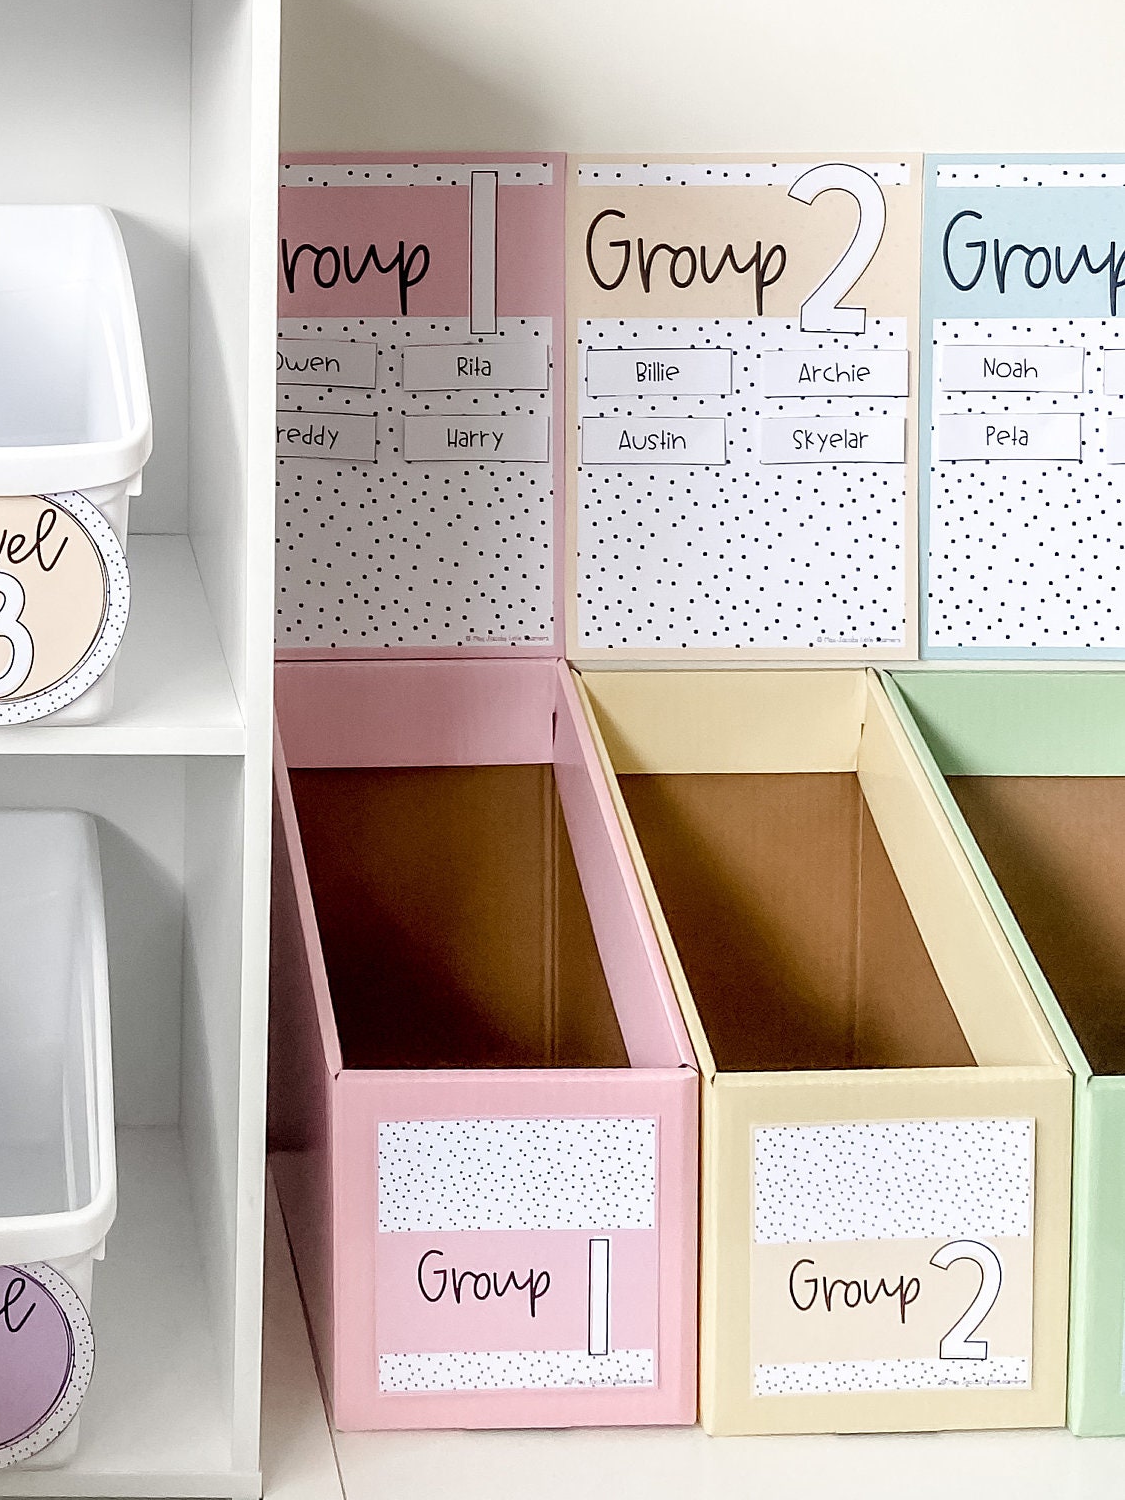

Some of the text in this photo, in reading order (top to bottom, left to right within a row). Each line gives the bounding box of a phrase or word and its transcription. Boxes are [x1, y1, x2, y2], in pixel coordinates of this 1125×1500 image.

[585, 163, 886, 334] Group 2
[277, 239, 430, 316] roup
[457, 356, 492, 377] Rita
[635, 361, 871, 383] Billie Archie
[983, 357, 1038, 378] Noah
[276, 424, 504, 452] reddy Harry
[618, 429, 869, 453] Austin Skyelar
[986, 425, 1029, 446] Peta
[417, 1249, 552, 1318] Group
[789, 1239, 1003, 1361] Group 2
